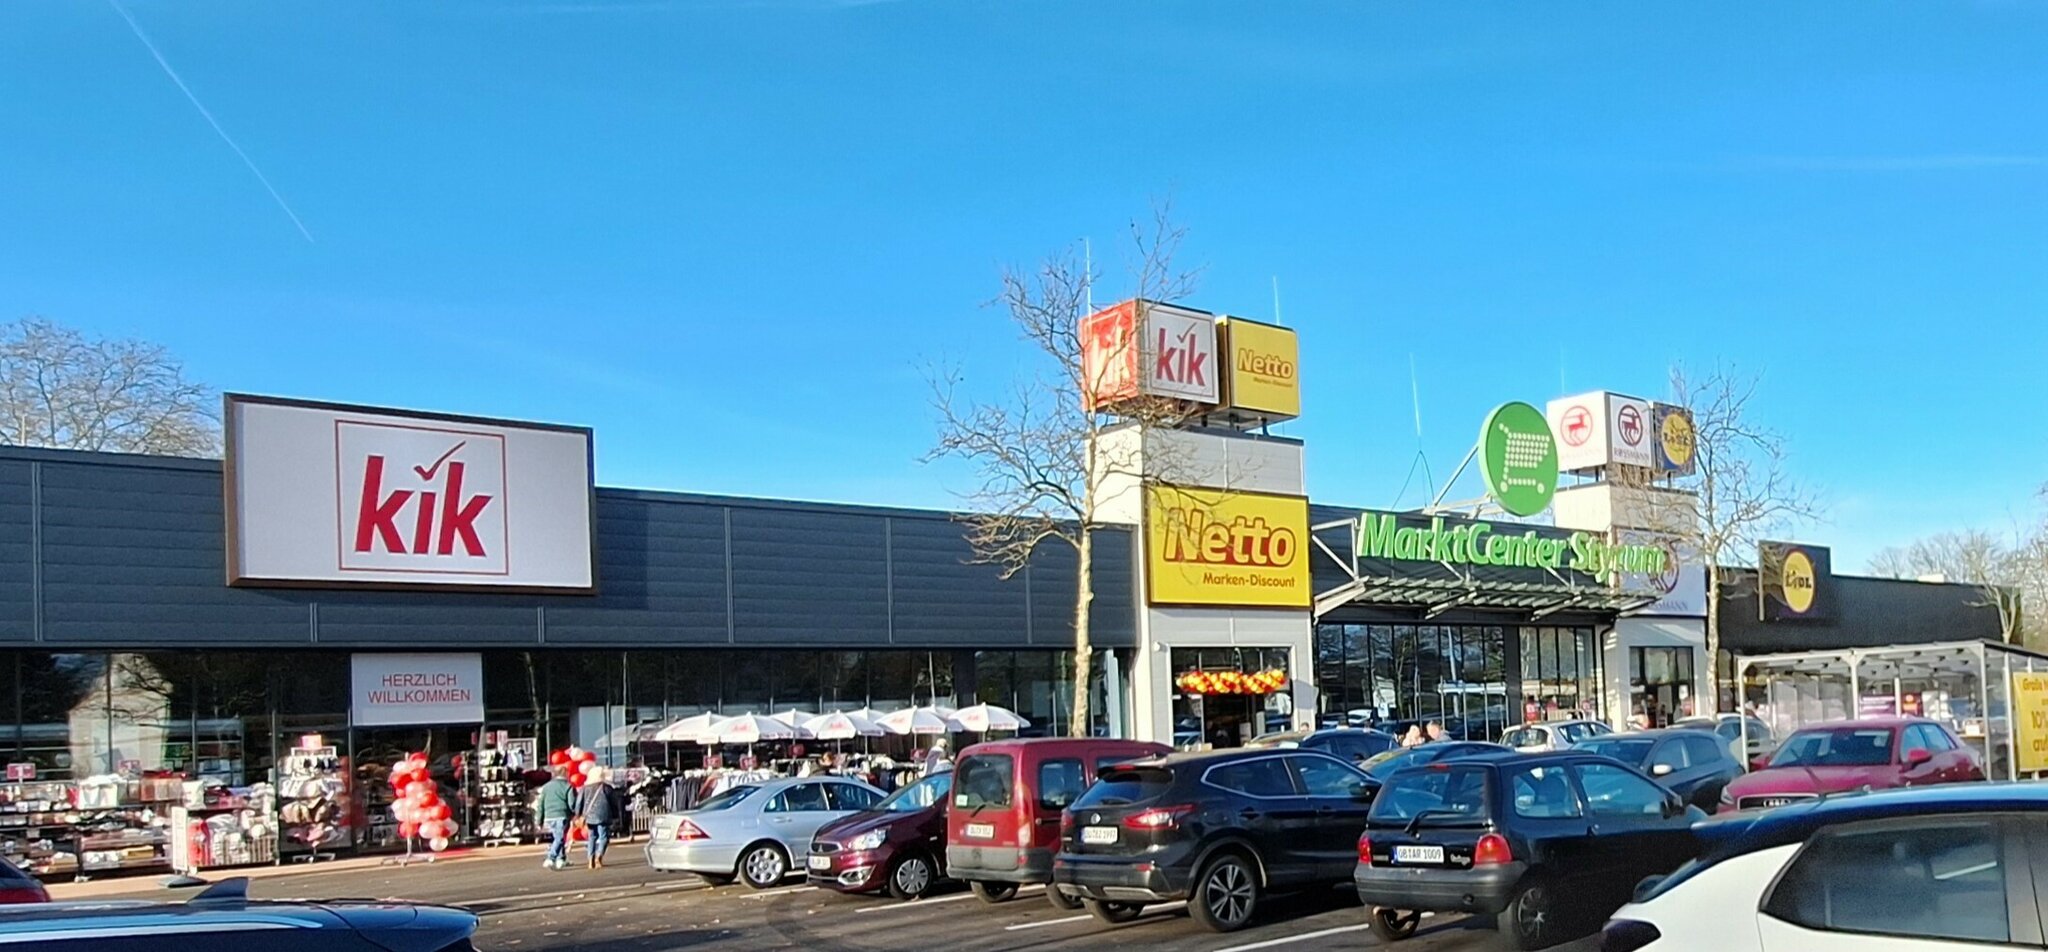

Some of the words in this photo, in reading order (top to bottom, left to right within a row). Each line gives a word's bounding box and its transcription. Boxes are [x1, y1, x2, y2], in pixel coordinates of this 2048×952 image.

[1156, 323, 1208, 387] kik
[1237, 348, 1294, 379] Netto
[355, 441, 494, 557] kik
[1164, 507, 1296, 568] Netto
[1357, 512, 1569, 567] MarktCenter
[1203, 572, 1295, 588] Marken-Discount
[382, 673, 457, 687] HERZLICH
[368, 689, 471, 704] WILLKOMMEN
[1424, 848, 1442, 859] 1009
